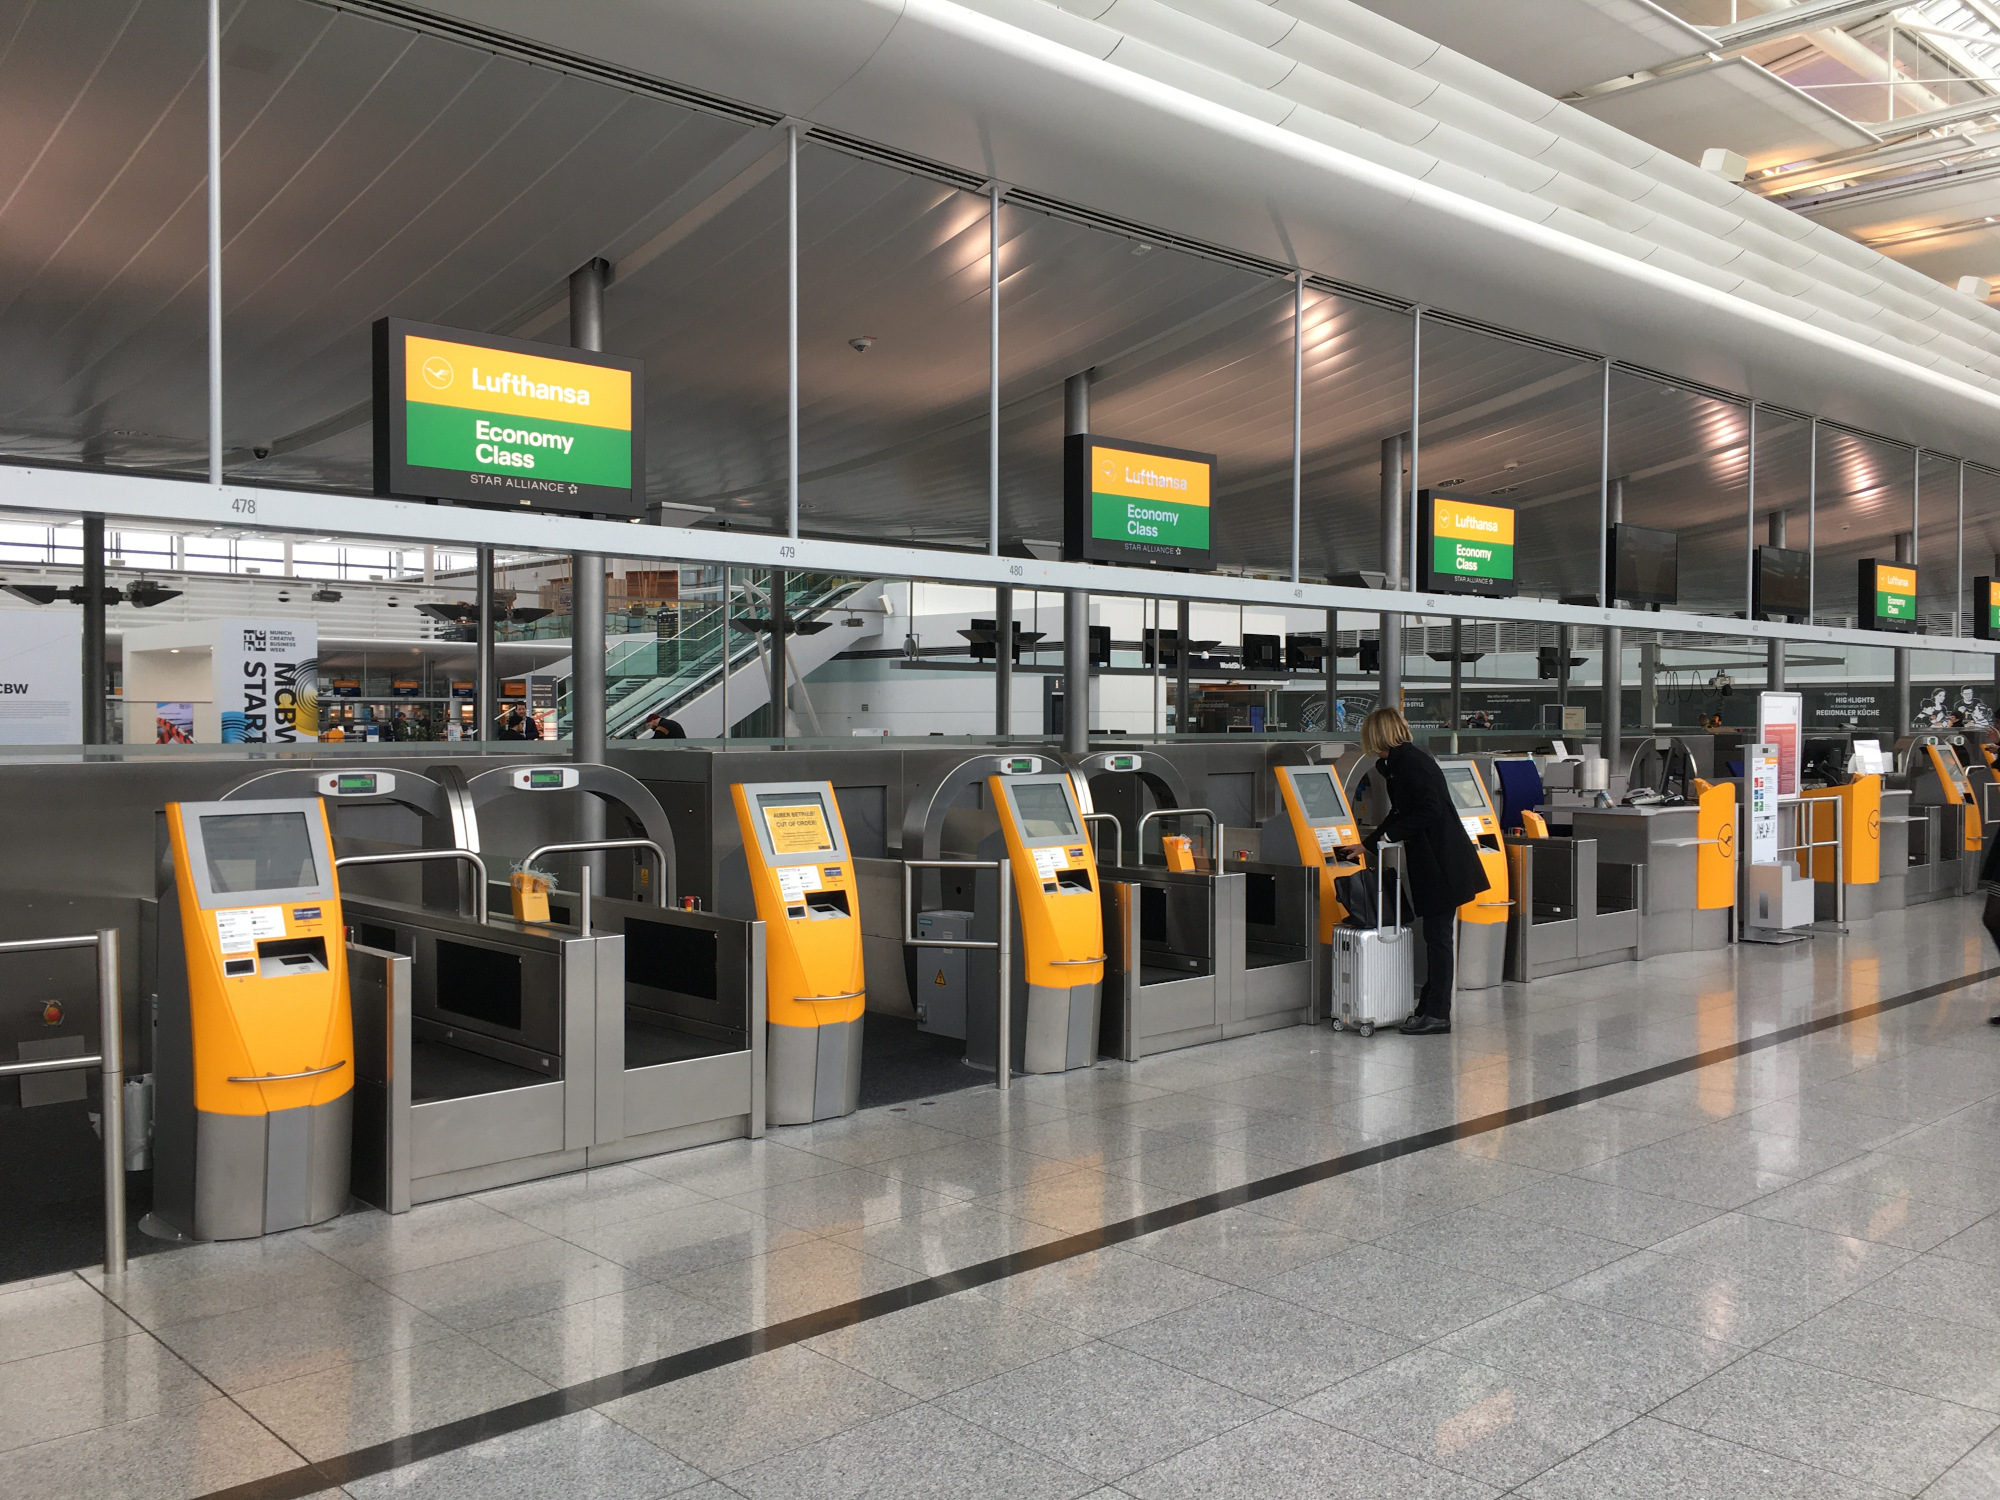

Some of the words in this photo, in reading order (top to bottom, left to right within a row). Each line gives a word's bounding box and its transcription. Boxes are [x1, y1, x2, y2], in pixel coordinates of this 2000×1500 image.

[472, 367, 590, 406] Lufthansa
[476, 419, 574, 454] Economy
[475, 444, 535, 469] Class
[470, 474, 501, 487] STAR
[506, 478, 565, 493] ALLIANCE
[1125, 467, 1187, 490] Lufthansa
[232, 498, 256, 514] 478
[1127, 503, 1179, 526] Economy
[1127, 520, 1158, 537] Class
[1455, 514, 1498, 532] Lufthansa
[780, 546, 795, 558] 479
[1124, 543, 1142, 551] STAR
[1143, 545, 1174, 555] ALLIANCE
[1456, 544, 1492, 561] Economy
[1010, 565, 1023, 576] 480
[1456, 558, 1477, 571] Class
[1857, 708, 1880, 716] KÜCHE
